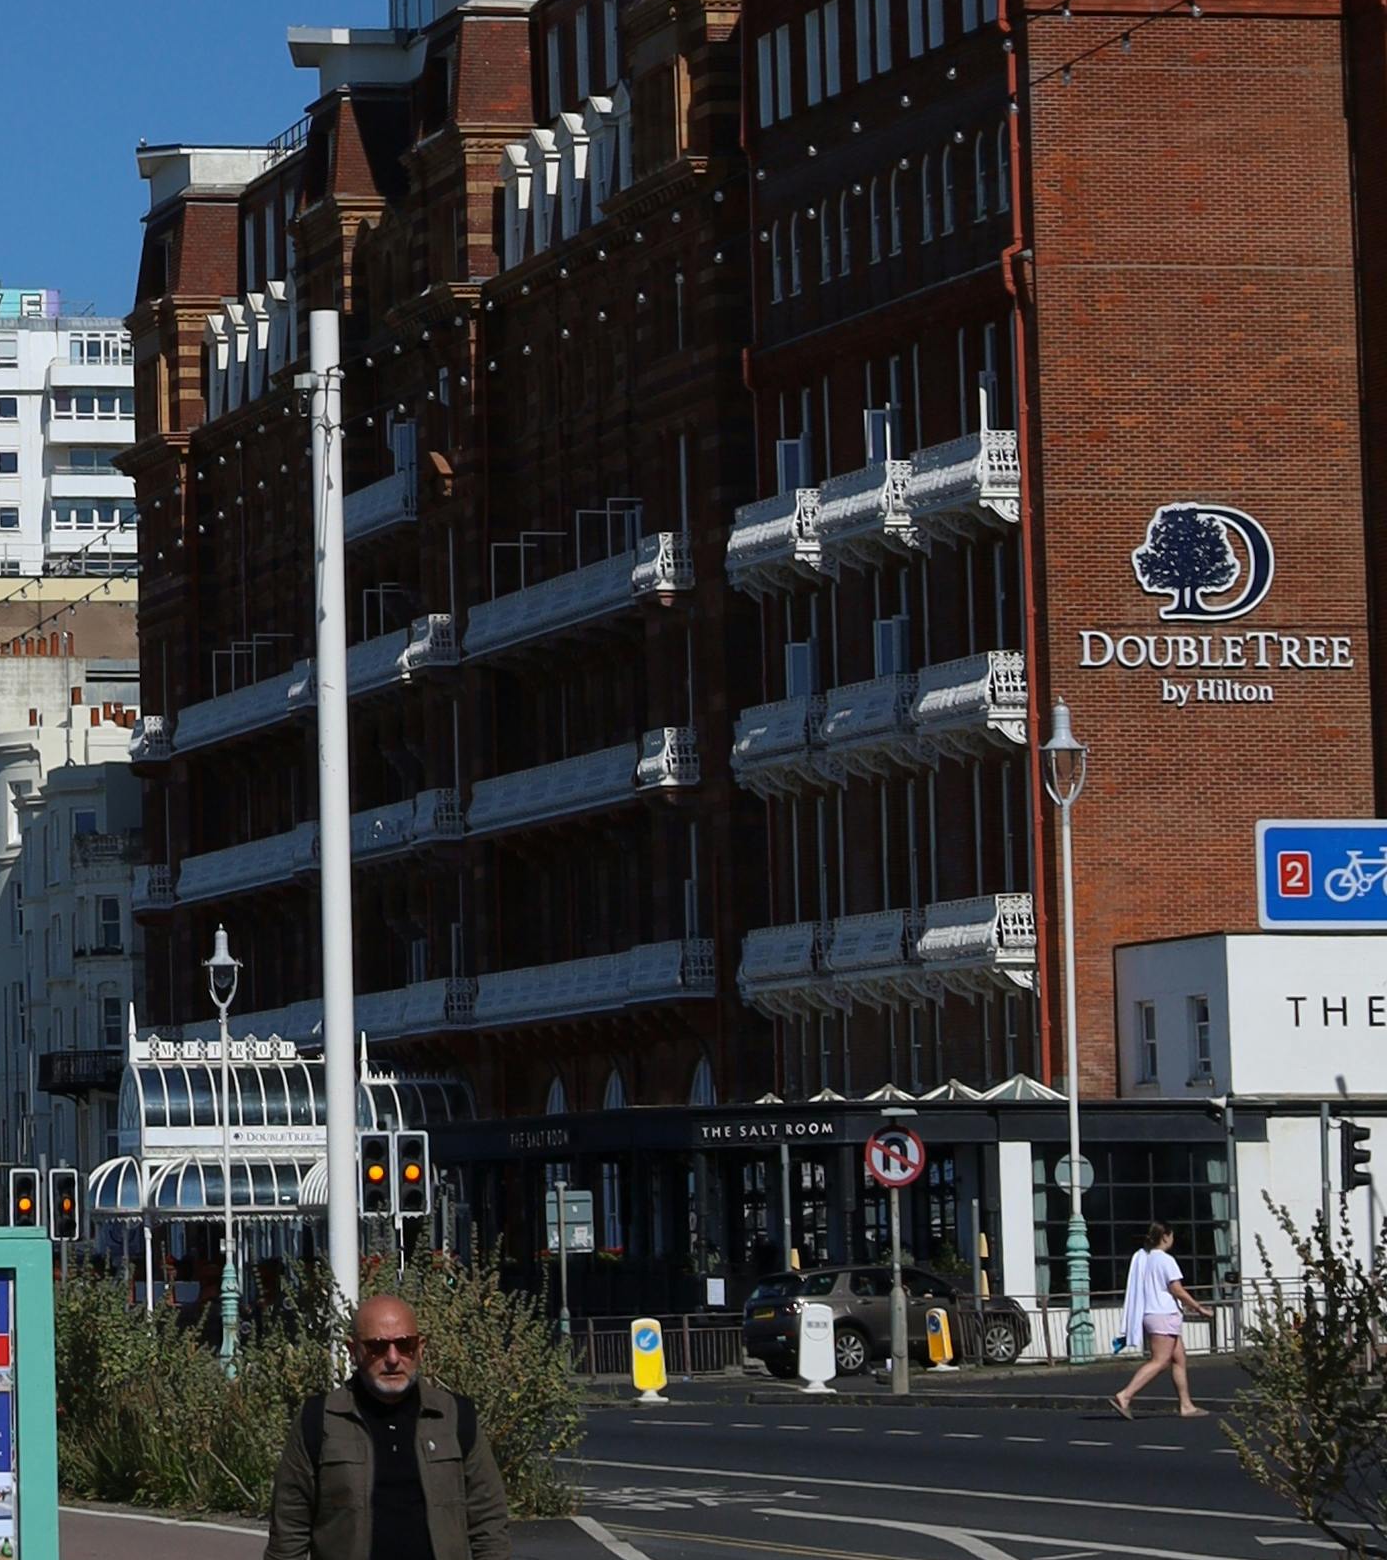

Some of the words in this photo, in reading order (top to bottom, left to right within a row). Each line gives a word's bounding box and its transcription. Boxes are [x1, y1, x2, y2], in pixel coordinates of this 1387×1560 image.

[1161, 678, 1191, 707] by
[1196, 678, 1274, 703] Hilton
[1285, 861, 1304, 888] 2
[1285, 996, 1386, 1028] THE
[701, 1123, 731, 1138] THE
[739, 1123, 777, 1138] SALT
[785, 1123, 833, 1138] ROOM
